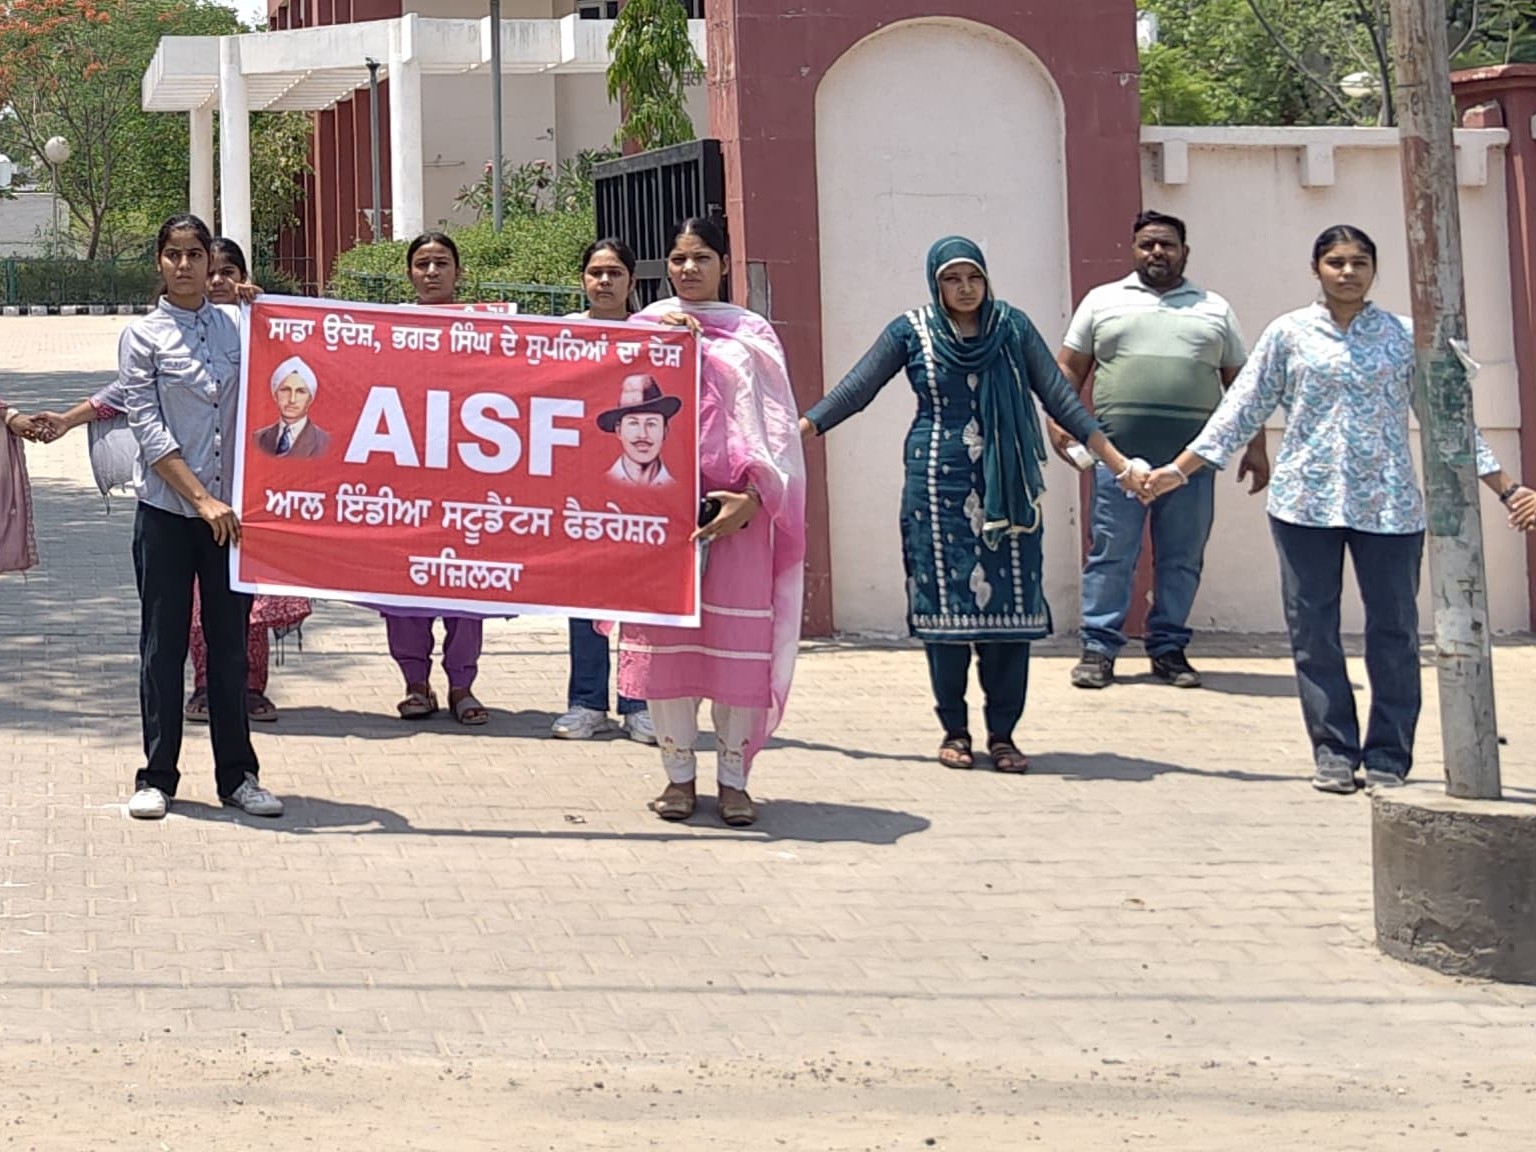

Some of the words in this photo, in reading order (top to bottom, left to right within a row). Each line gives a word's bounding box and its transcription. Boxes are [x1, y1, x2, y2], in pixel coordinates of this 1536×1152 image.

[268, 316, 315, 344] ਸਾਡਾ
[391, 325, 443, 352] ਭਗਤ
[449, 320, 493, 355] ਸਿੰਘ
[500, 325, 518, 357] ਦੇ
[525, 328, 609, 365] ਸੁਪਨਿਆਂ
[616, 342, 640, 364] ਦਾ
[647, 335, 683, 369] ਦੇਸ਼
[344, 385, 586, 477] AISF
[265, 489, 325, 522] ਆਲ
[336, 483, 431, 528] ਇੰਡੀਆ
[442, 491, 553, 545] ਸਟੂਡੈਂਟਸ
[562, 496, 669, 546] ਫੈਡਰੇਸ਼ਨ
[408, 548, 524, 591] ਫਾਜ਼ਿਲਕਾ
